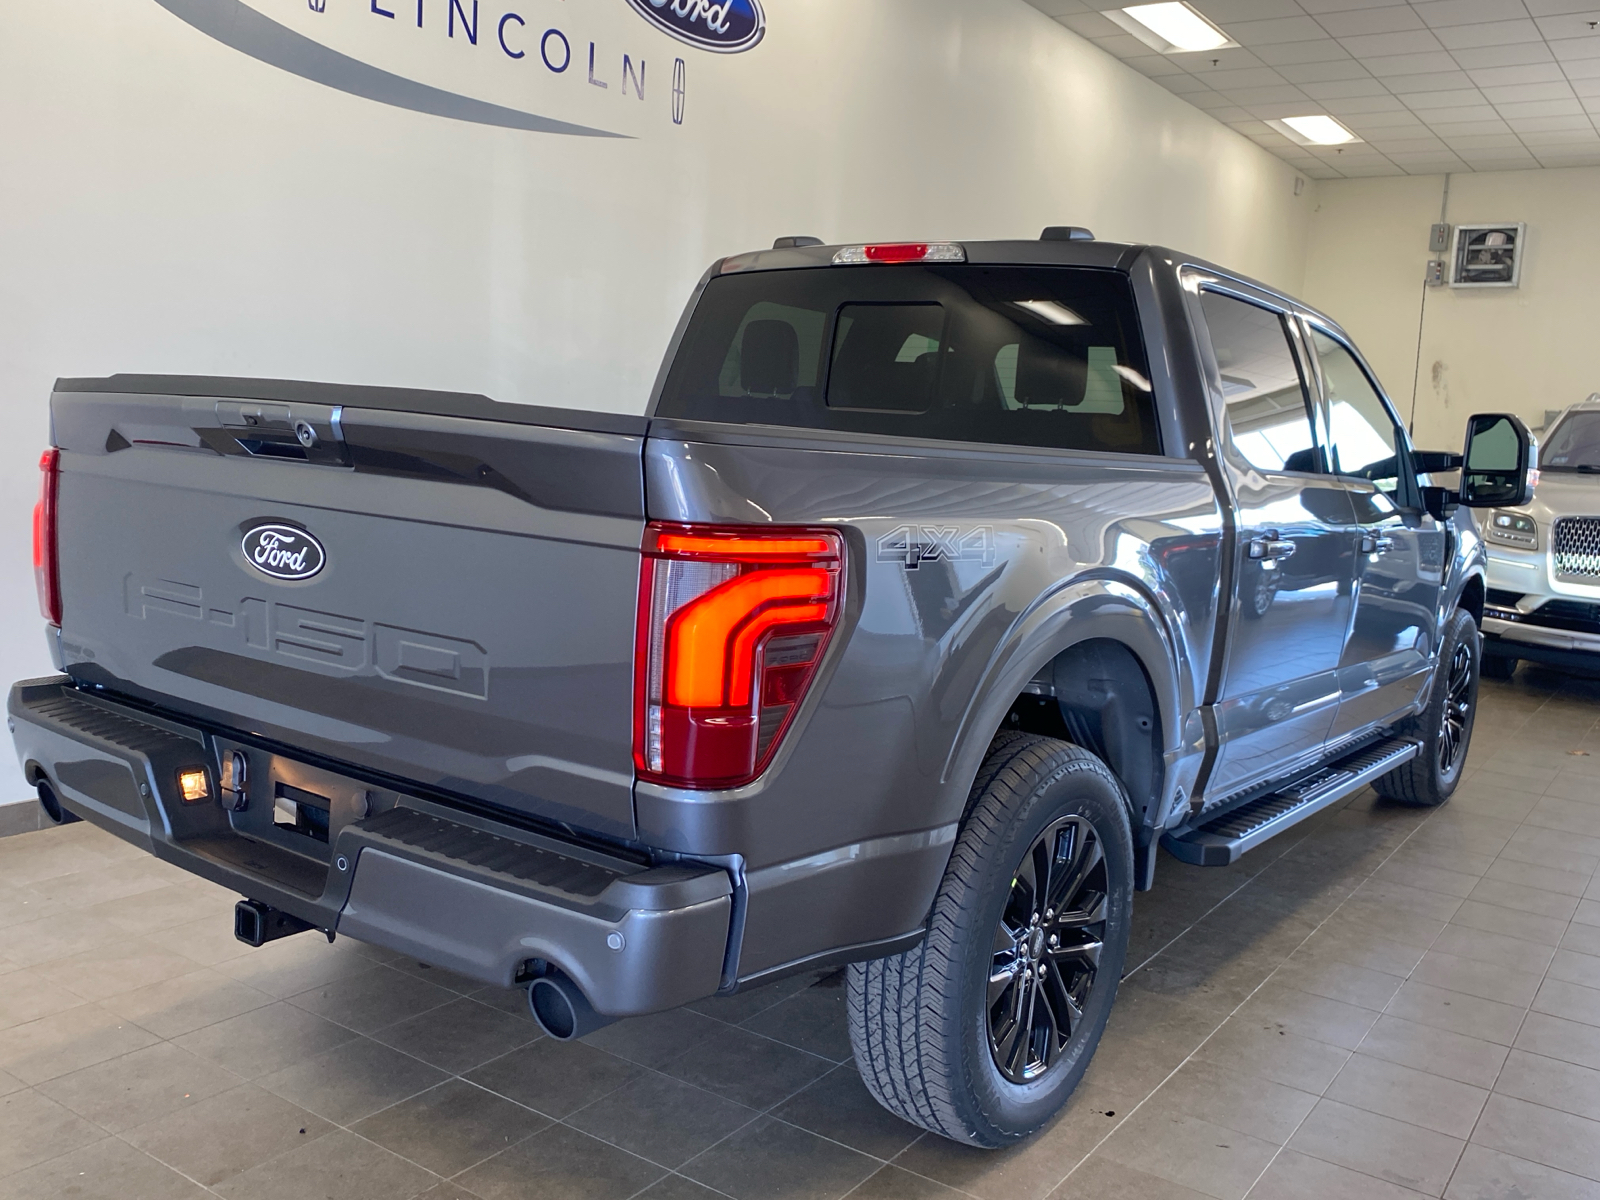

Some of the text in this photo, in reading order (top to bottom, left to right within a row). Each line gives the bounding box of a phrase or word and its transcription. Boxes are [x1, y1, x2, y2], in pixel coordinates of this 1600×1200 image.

[651, 0, 730, 34] ord
[254, 531, 308, 571] Ford
[123, 571, 488, 700] F-150
